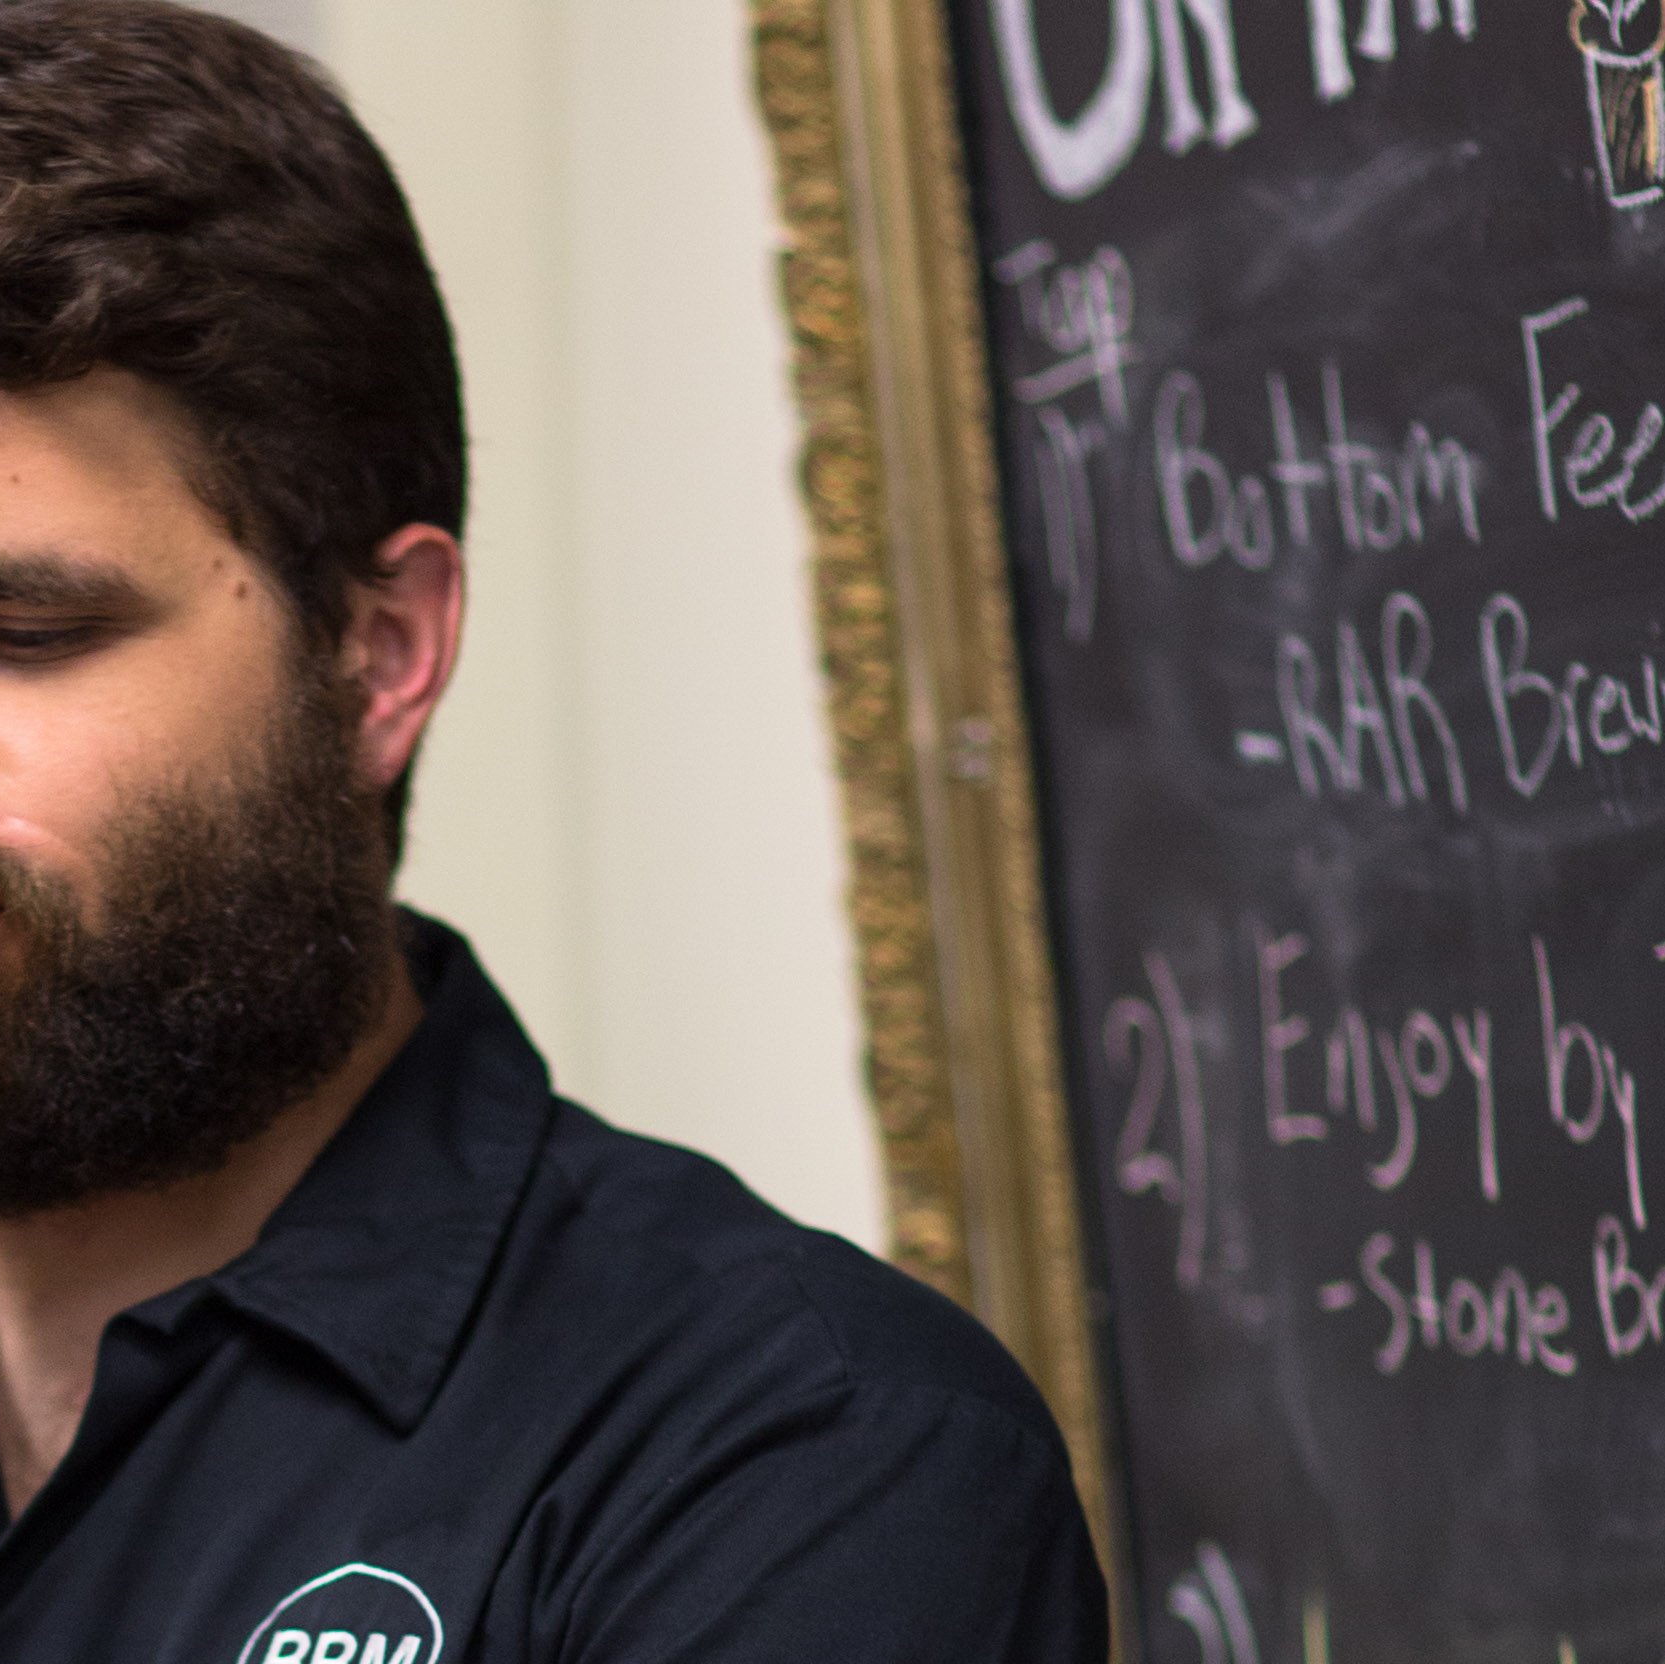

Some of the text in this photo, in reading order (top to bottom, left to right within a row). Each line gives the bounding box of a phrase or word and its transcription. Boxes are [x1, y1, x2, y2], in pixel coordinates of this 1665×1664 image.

[1153, 357, 1481, 570] Bottom
[1236, 591, 1665, 813] -RAR Brew
[1103, 920, 1646, 1290] 2) Enjoy by
